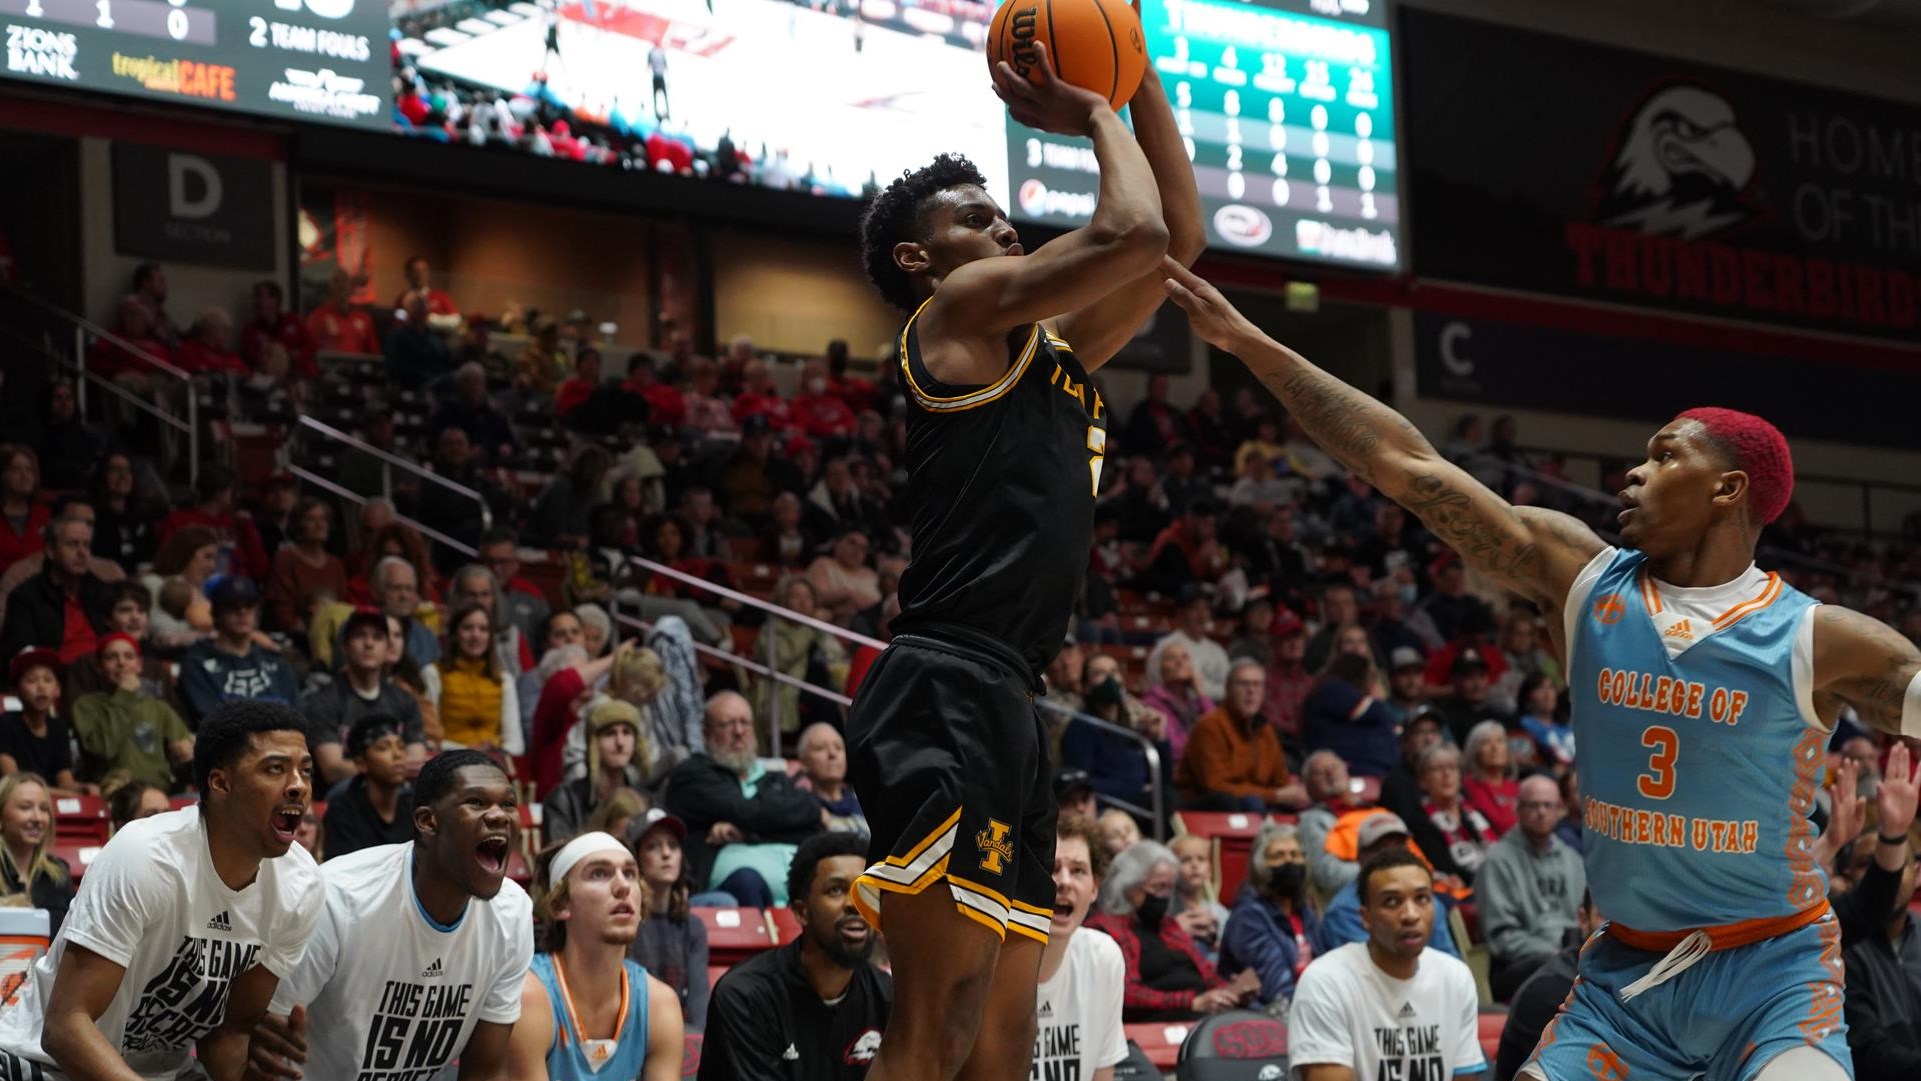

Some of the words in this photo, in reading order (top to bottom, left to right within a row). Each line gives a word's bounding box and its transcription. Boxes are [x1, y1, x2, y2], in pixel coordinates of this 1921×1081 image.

[6, 25, 77, 56] ZIONS
[167, 9, 189, 40] 0
[250, 17, 268, 47] 2
[270, 22, 315, 52] TEAM
[317, 31, 370, 61] FOULS
[7, 49, 80, 80] BANK
[180, 60, 237, 101] CAFE
[168, 153, 222, 218] D
[1793, 182, 1853, 242] OF
[1862, 193, 1921, 255] TH
[1565, 222, 1921, 329] THUNDERBIRD
[1440, 322, 1475, 375] C
[1598, 668, 1705, 719] COLLEGE
[1710, 687, 1748, 725] OF
[1637, 725, 1680, 800] 3
[977, 831, 1013, 860] Vandals
[1585, 796, 1685, 847] SOUTHERN
[1692, 818, 1758, 853] UTAH
[206, 922, 233, 932] adidas
[208, 938, 261, 980] GAME
[378, 981, 424, 1018] THIS
[421, 984, 472, 1019] GAME
[362, 1014, 412, 1070] IS
[402, 1019, 464, 1069] NO
[1044, 1024, 1080, 1058] GAME
[1374, 1027, 1404, 1057] THIS
[1407, 1024, 1441, 1056] GAME
